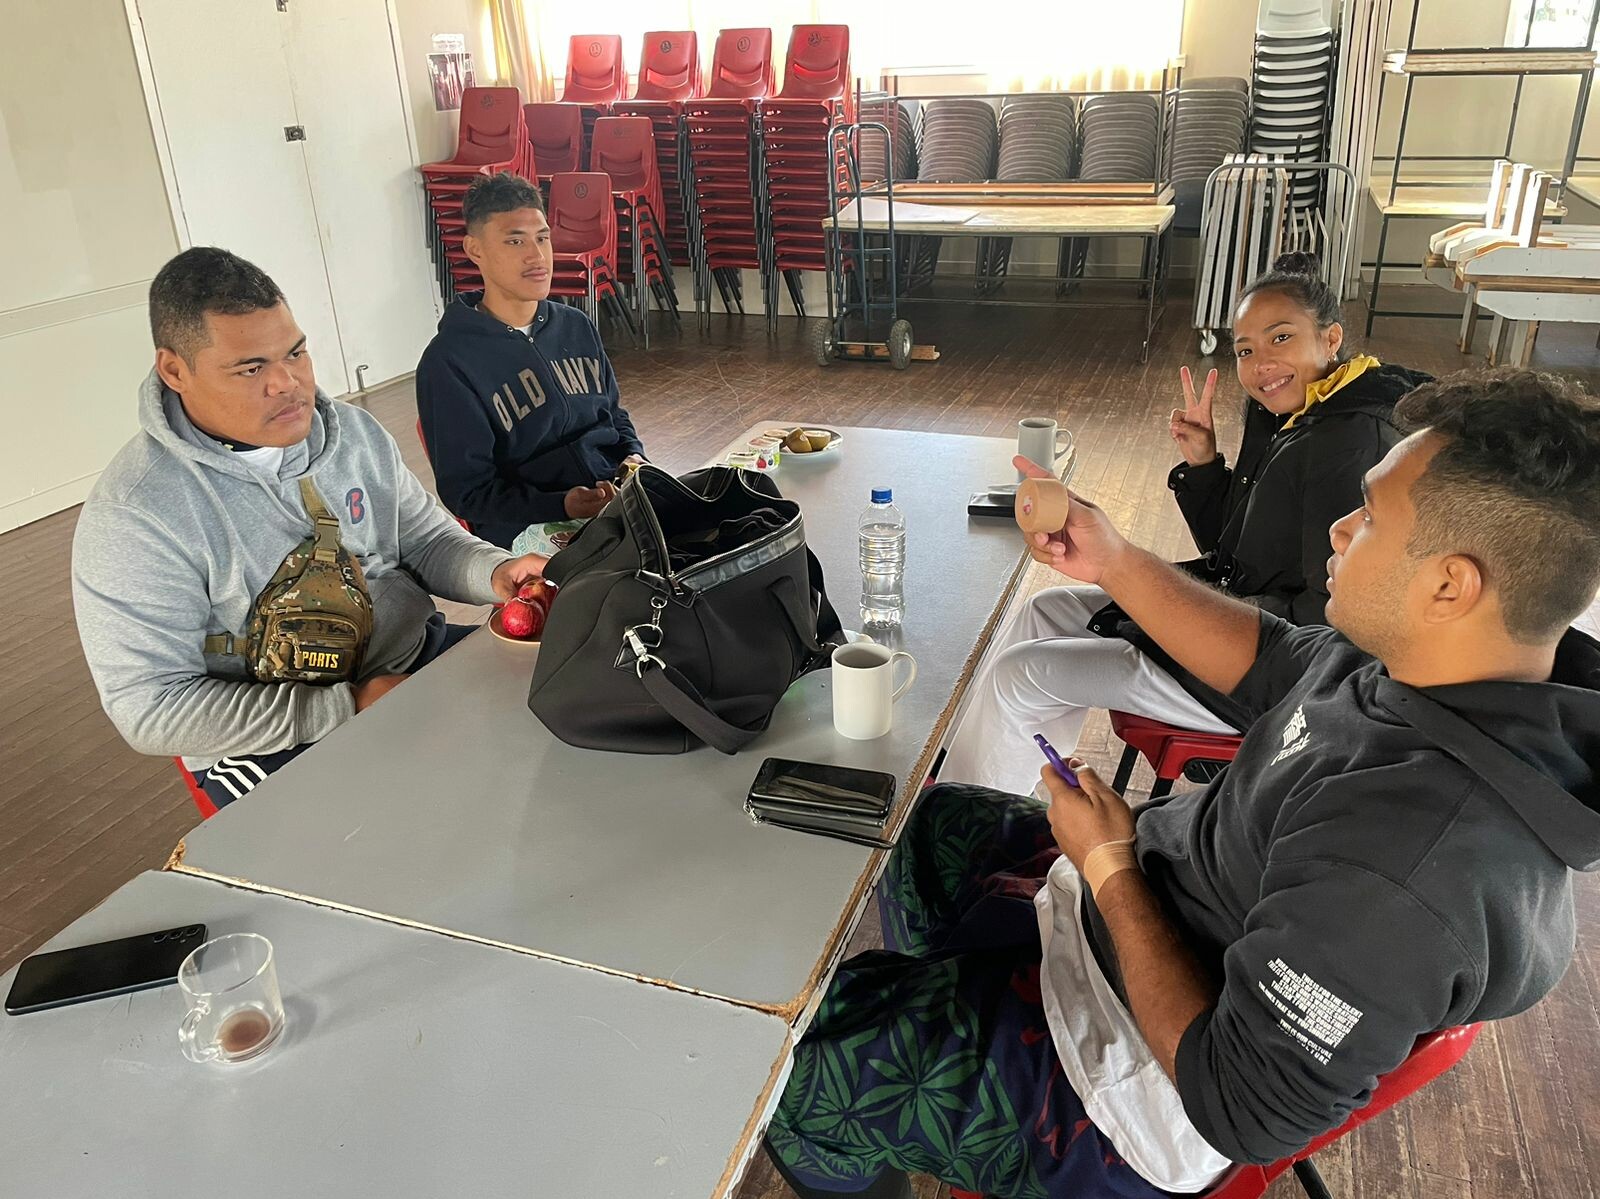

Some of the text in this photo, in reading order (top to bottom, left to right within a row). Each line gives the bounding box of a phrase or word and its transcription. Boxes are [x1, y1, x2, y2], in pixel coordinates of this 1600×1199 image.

[493, 357, 602, 432] OLD NAVY
[346, 487, 365, 524] B
[295, 651, 339, 669] PORTS
